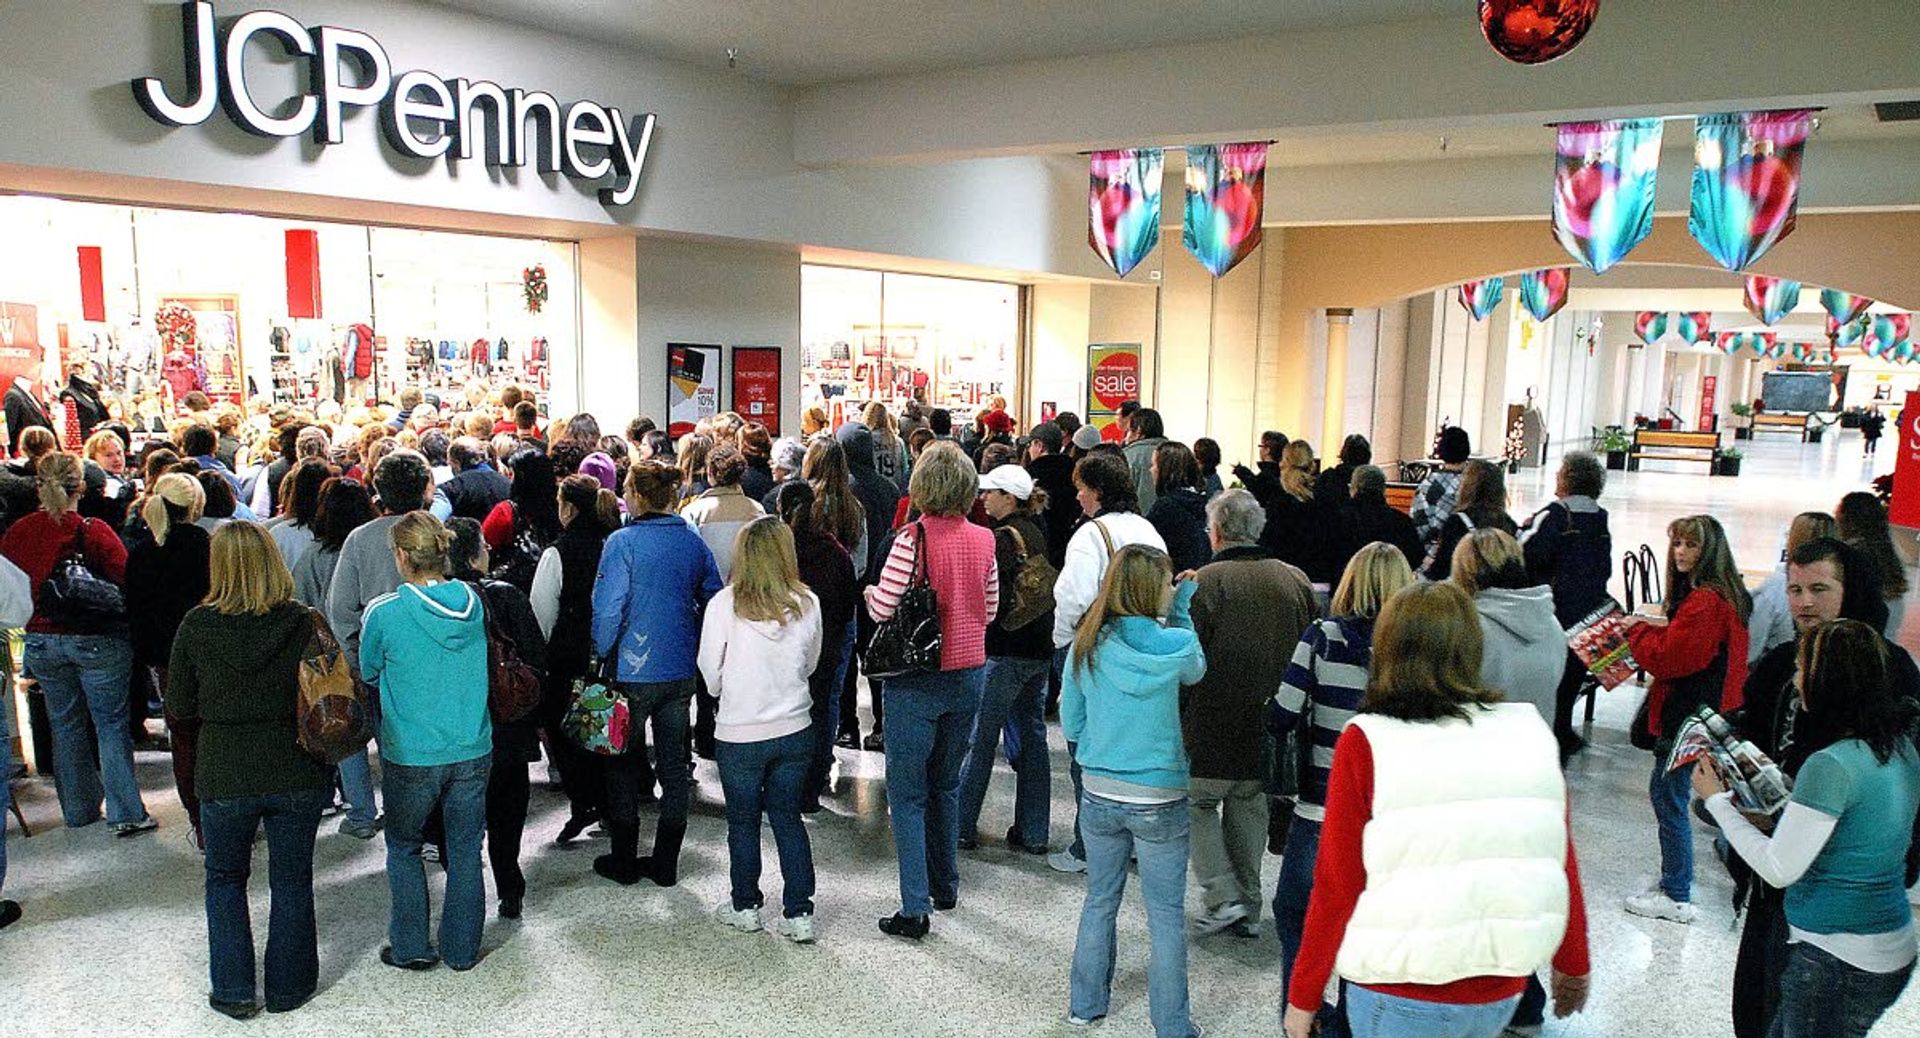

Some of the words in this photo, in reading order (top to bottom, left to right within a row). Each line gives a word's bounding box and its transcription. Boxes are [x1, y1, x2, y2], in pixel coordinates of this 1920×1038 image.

[132, 0, 656, 206] JCPenney
[1094, 372, 1137, 393] sale
[697, 395, 715, 407] 10%
[877, 453, 896, 477] 19
